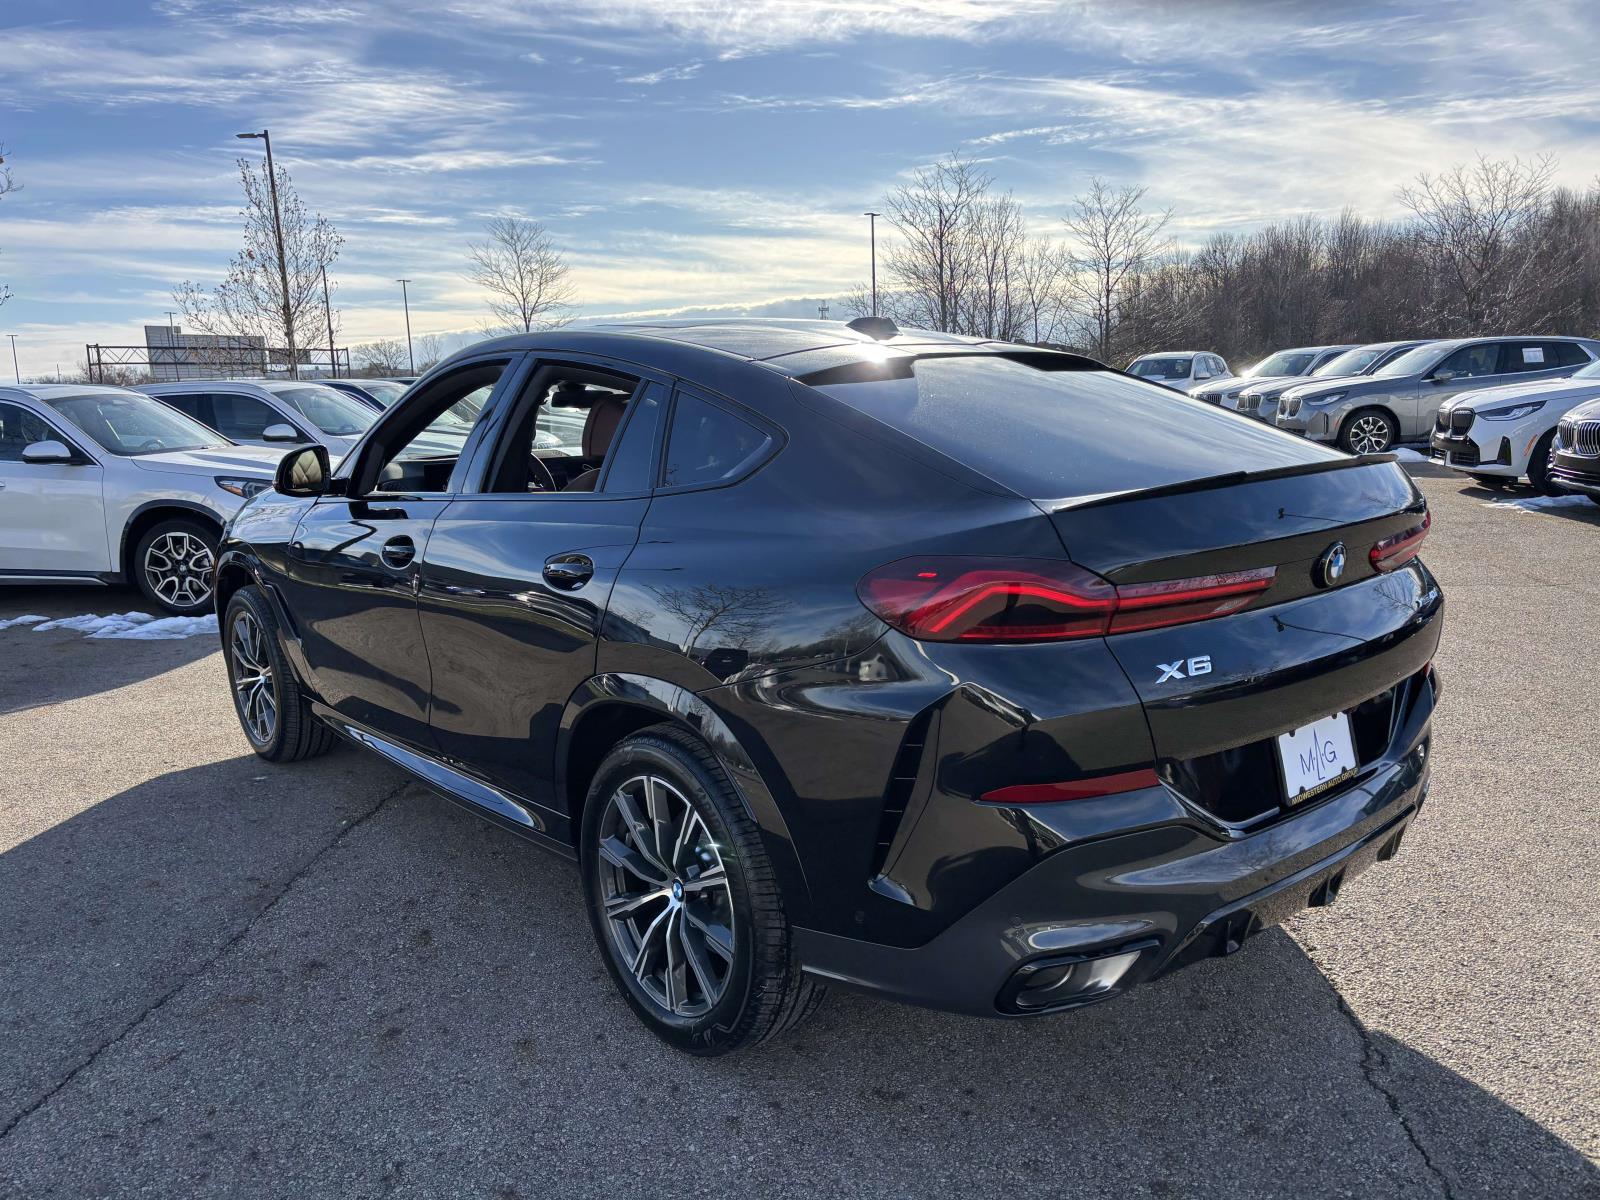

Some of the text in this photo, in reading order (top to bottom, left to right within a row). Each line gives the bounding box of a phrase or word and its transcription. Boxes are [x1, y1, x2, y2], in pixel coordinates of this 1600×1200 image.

[1155, 655, 1212, 684] X6
[1292, 783, 1328, 805] MIDWESTERN
[1328, 775, 1341, 788] AUTO
